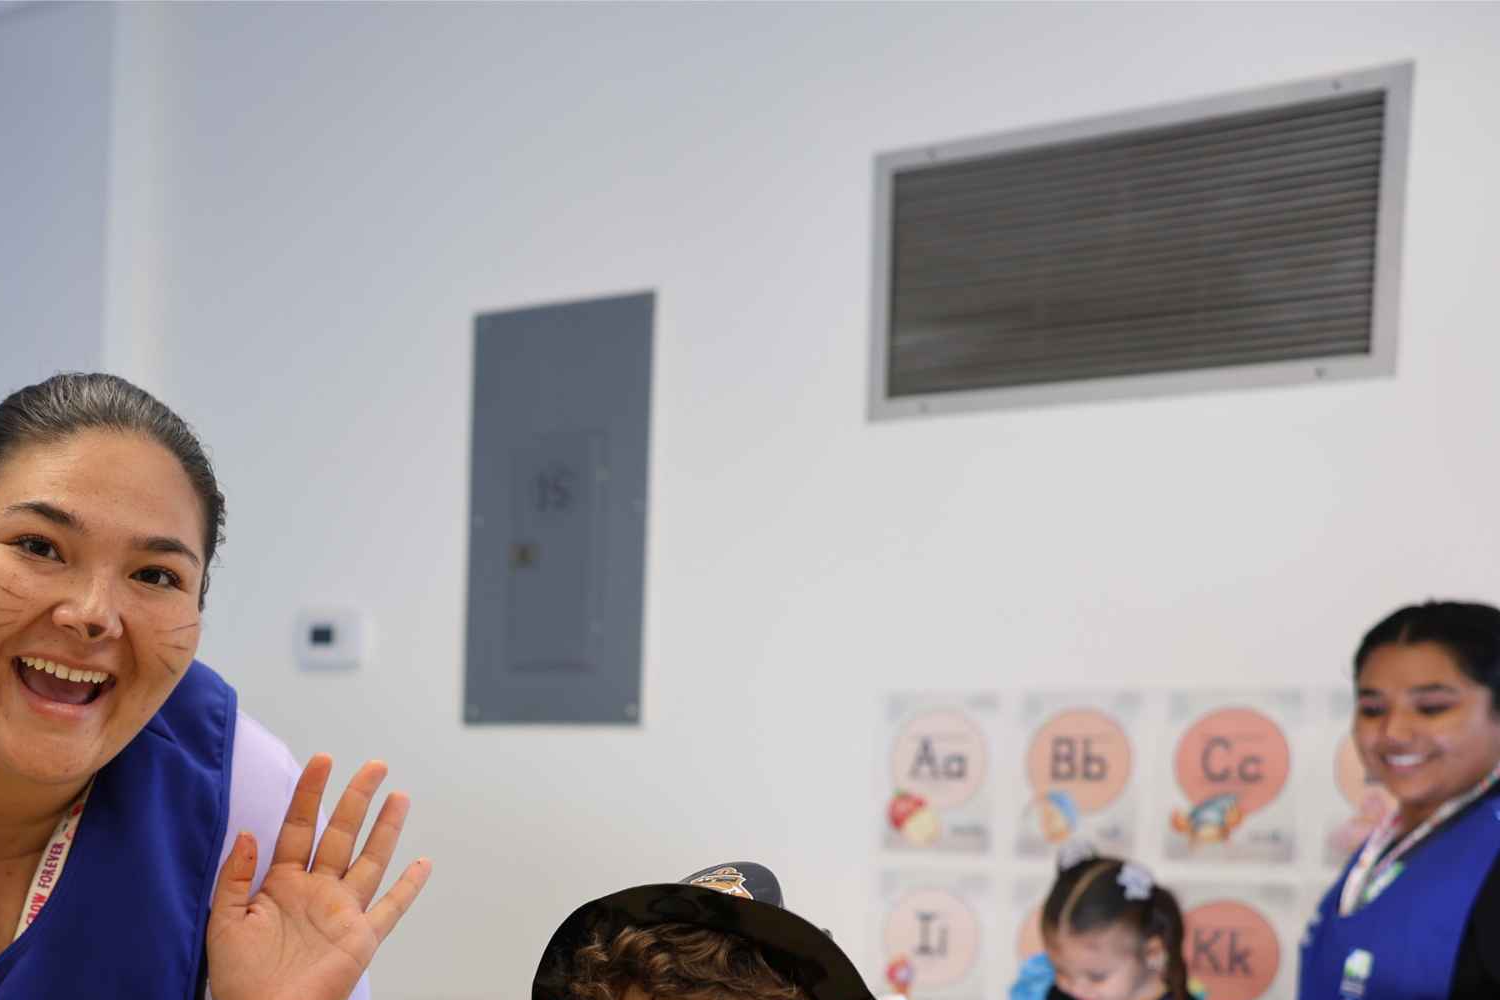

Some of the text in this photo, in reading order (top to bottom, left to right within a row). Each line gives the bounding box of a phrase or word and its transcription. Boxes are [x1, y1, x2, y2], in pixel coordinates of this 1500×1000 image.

[907, 735, 968, 780] Aa
[1051, 736, 1108, 781] Bb
[1201, 736, 1265, 784] Cc
[38, 842, 65, 889] FOREVER
[1190, 925, 1254, 978] Kk
